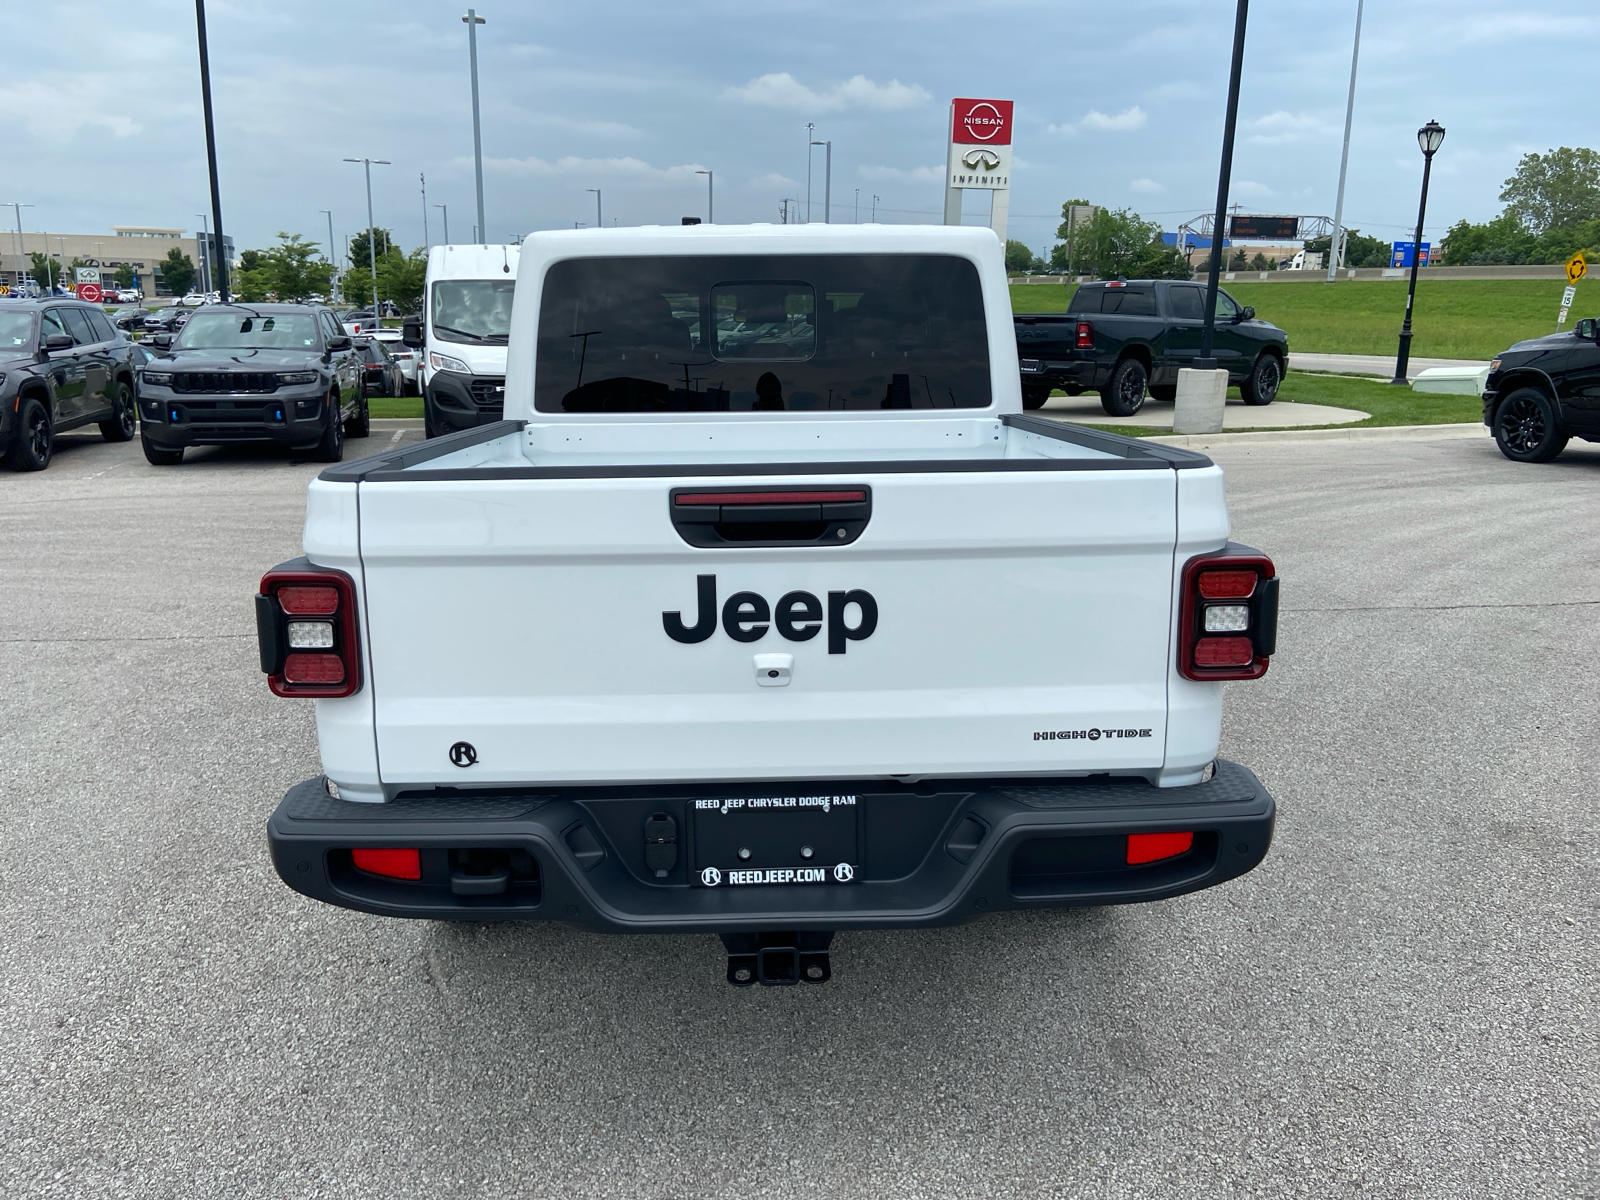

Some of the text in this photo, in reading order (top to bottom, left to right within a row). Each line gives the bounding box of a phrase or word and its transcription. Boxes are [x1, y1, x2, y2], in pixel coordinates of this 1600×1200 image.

[964, 117, 1003, 125] NISSAN
[953, 175, 1007, 185] INFINITI
[1563, 297, 1571, 305] 15
[662, 573, 878, 655] Jeep
[1033, 728, 1153, 740] HIGH TIDE
[695, 795, 856, 809] REED JEEP CHRYSLER DODGE RAM
[729, 868, 825, 885] REEDJEEP.COM
